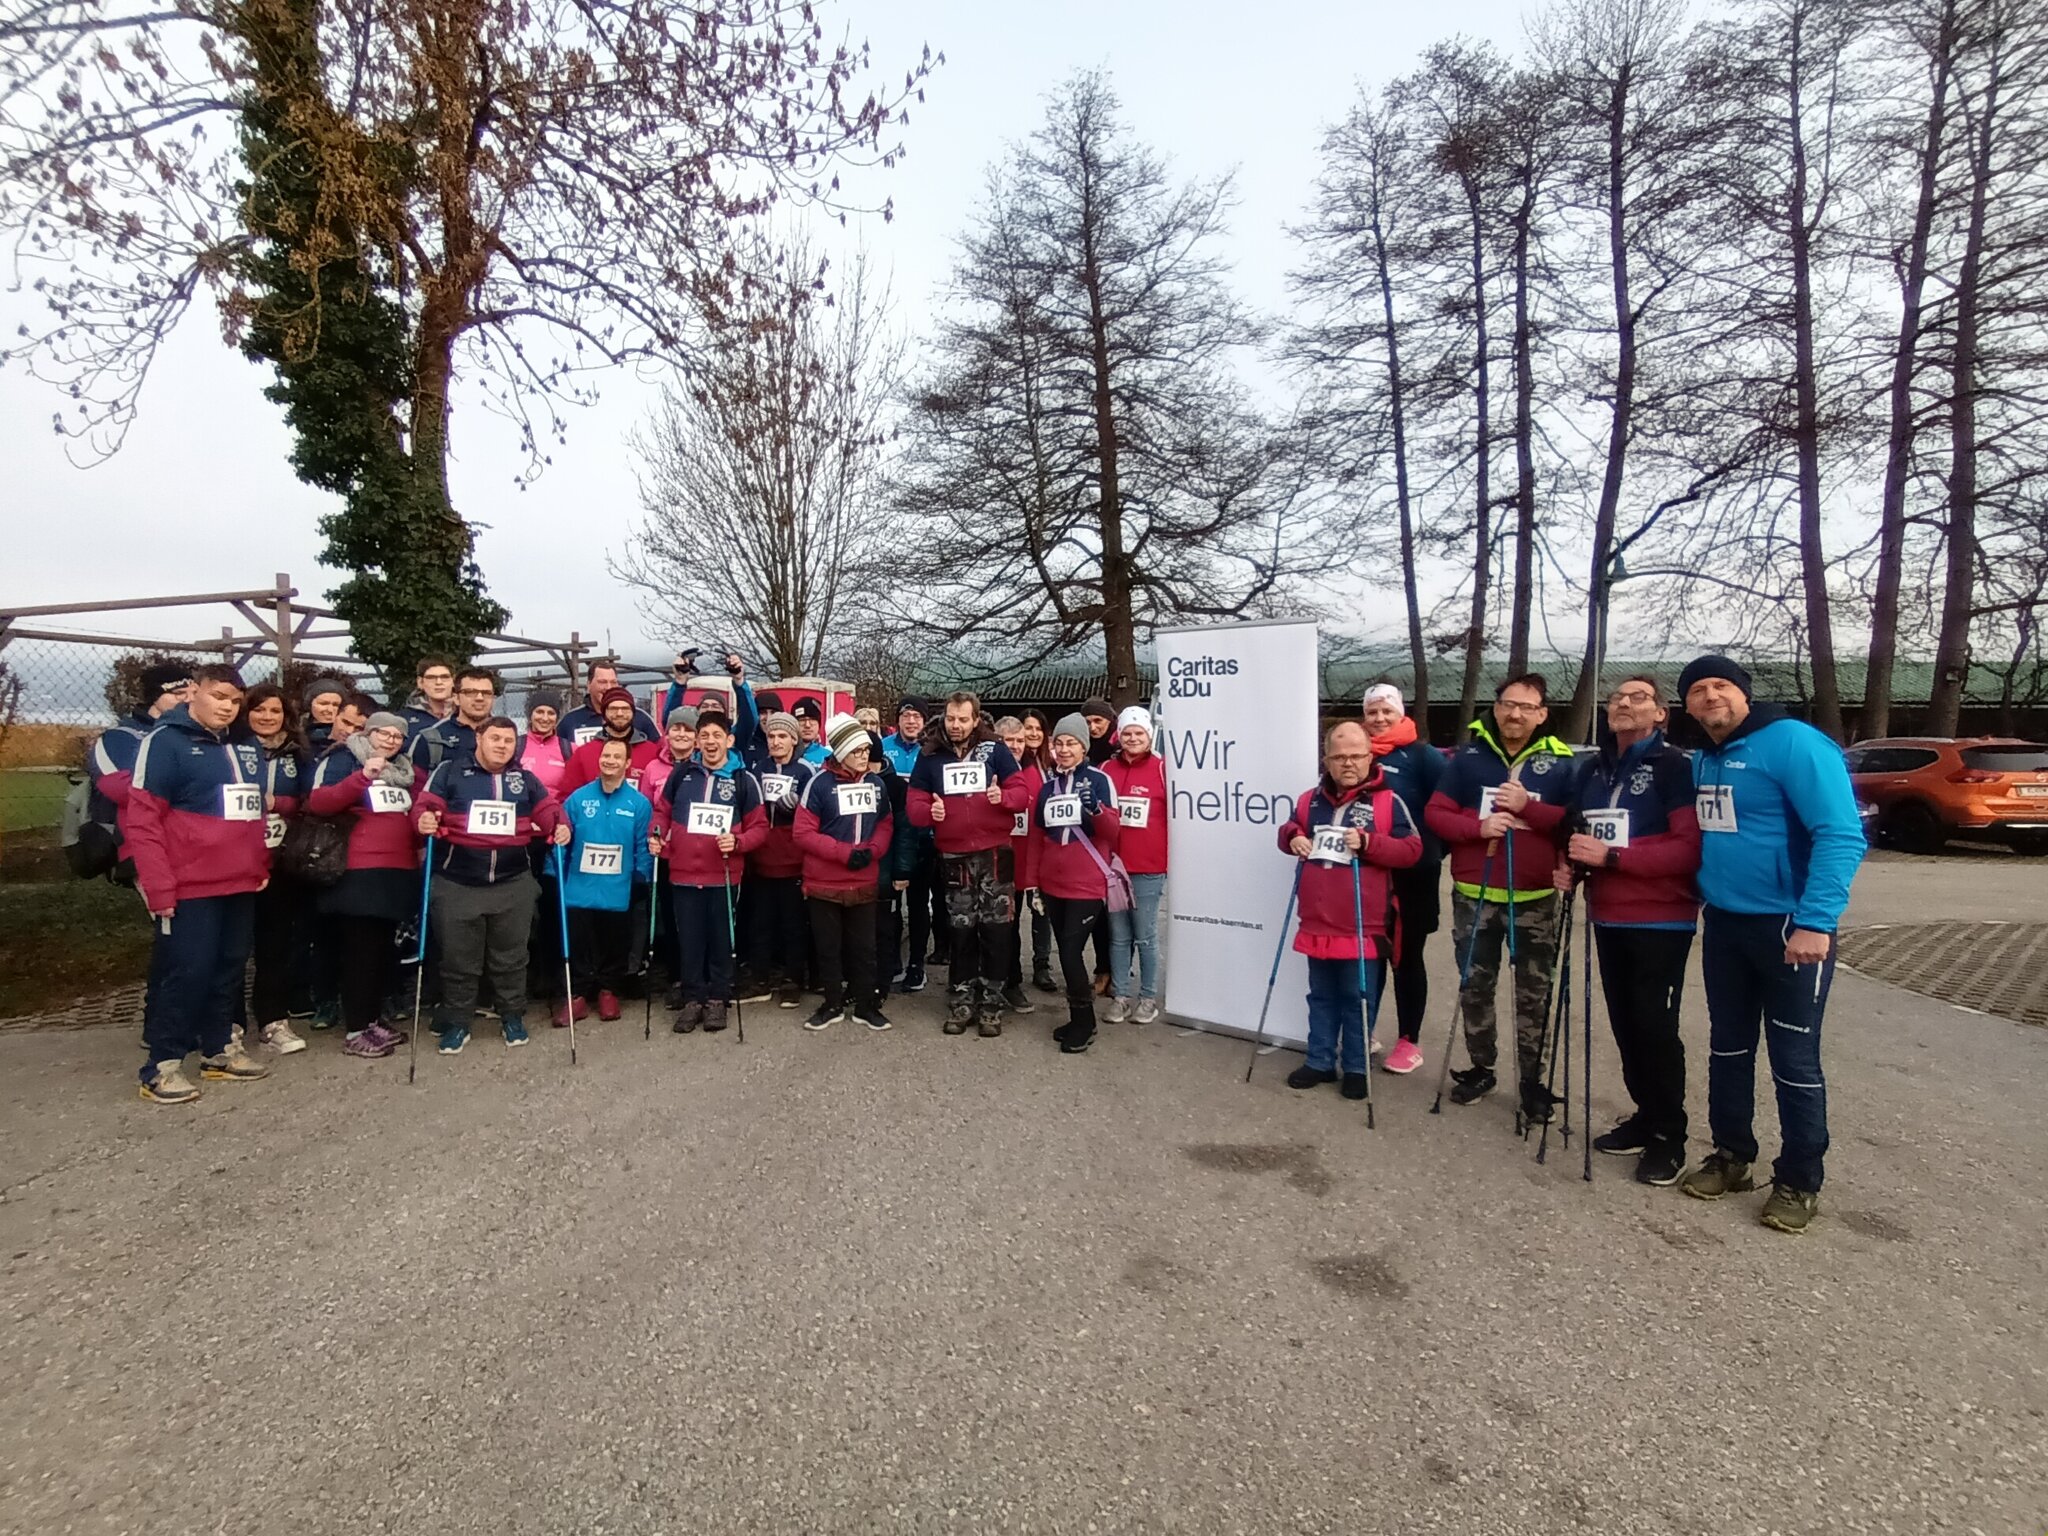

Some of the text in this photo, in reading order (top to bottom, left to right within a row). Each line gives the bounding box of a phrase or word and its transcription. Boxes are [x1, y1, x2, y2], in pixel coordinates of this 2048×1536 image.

[1168, 655, 1239, 677] Caritas
[1168, 677, 1211, 698] &Du
[1168, 730, 1236, 770] Wir
[951, 771, 978, 785] 173
[235, 795, 260, 811] 165
[380, 790, 405, 804] 154
[847, 792, 872, 806] 176
[1171, 780, 1294, 825] helfen
[1050, 803, 1073, 818] 150
[1701, 800, 1723, 820] 171
[479, 811, 508, 826] 151
[697, 813, 724, 828] 143
[1591, 822, 1616, 840] 68
[1317, 835, 1346, 853] 148
[590, 853, 616, 867] 177
